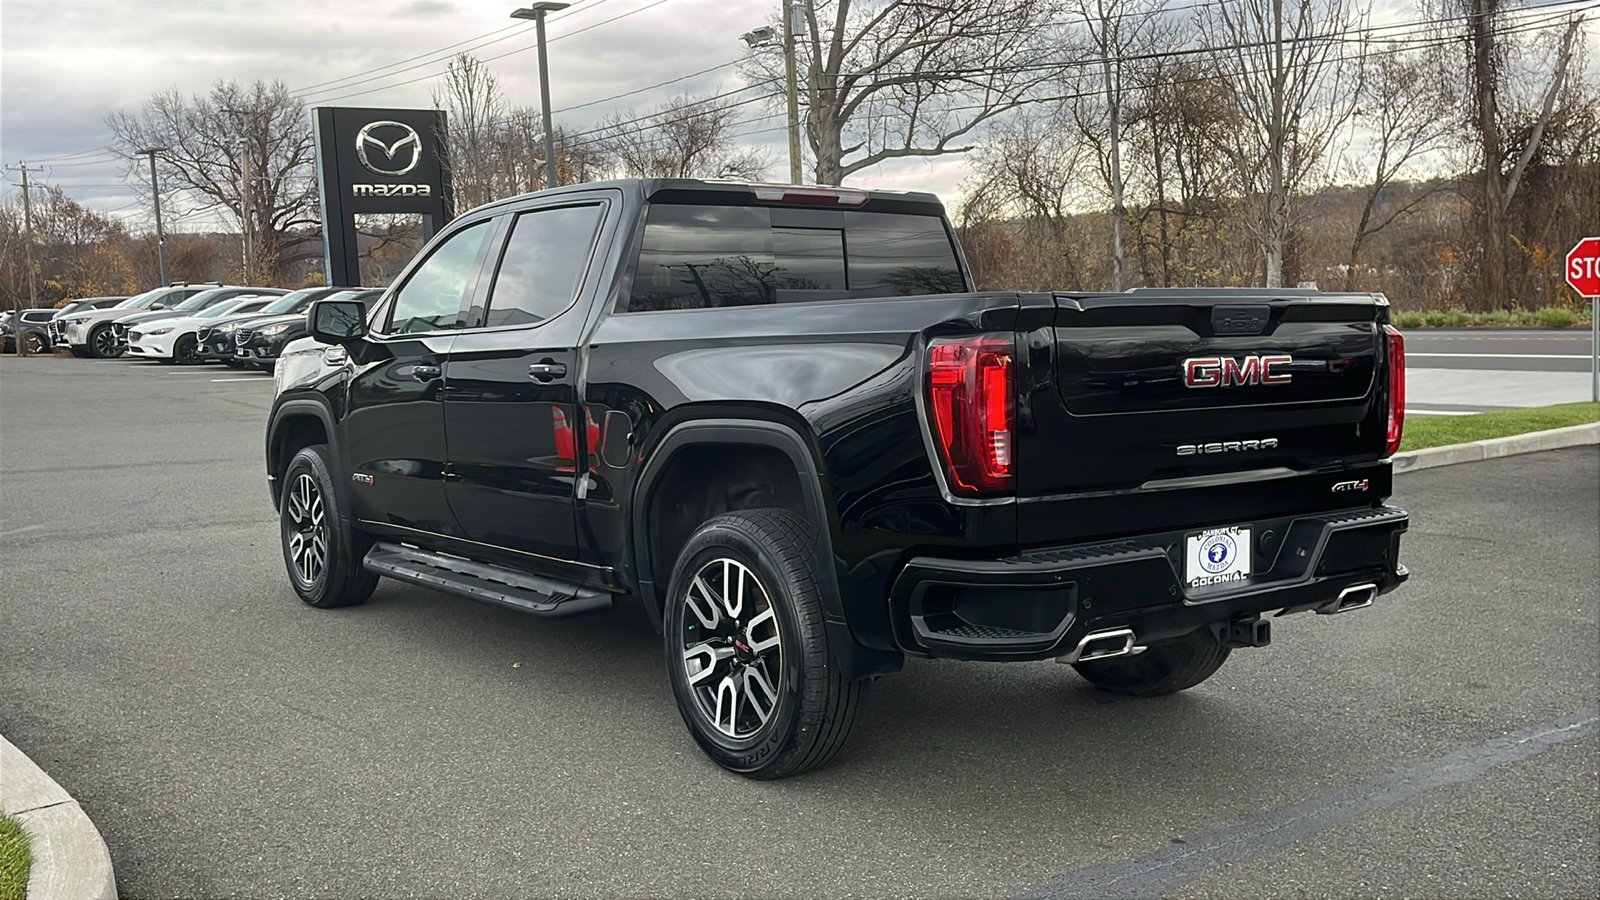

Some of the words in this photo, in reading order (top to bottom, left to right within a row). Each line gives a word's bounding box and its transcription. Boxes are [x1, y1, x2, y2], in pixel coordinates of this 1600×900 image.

[1184, 355, 1292, 388] GMC
[1176, 438, 1278, 456] SIERRA
[1331, 479, 1369, 492] AT4
[1204, 536, 1233, 550] COLONIAL
[1207, 561, 1228, 570] MAZDA
[1191, 572, 1247, 587] COLONIAL
